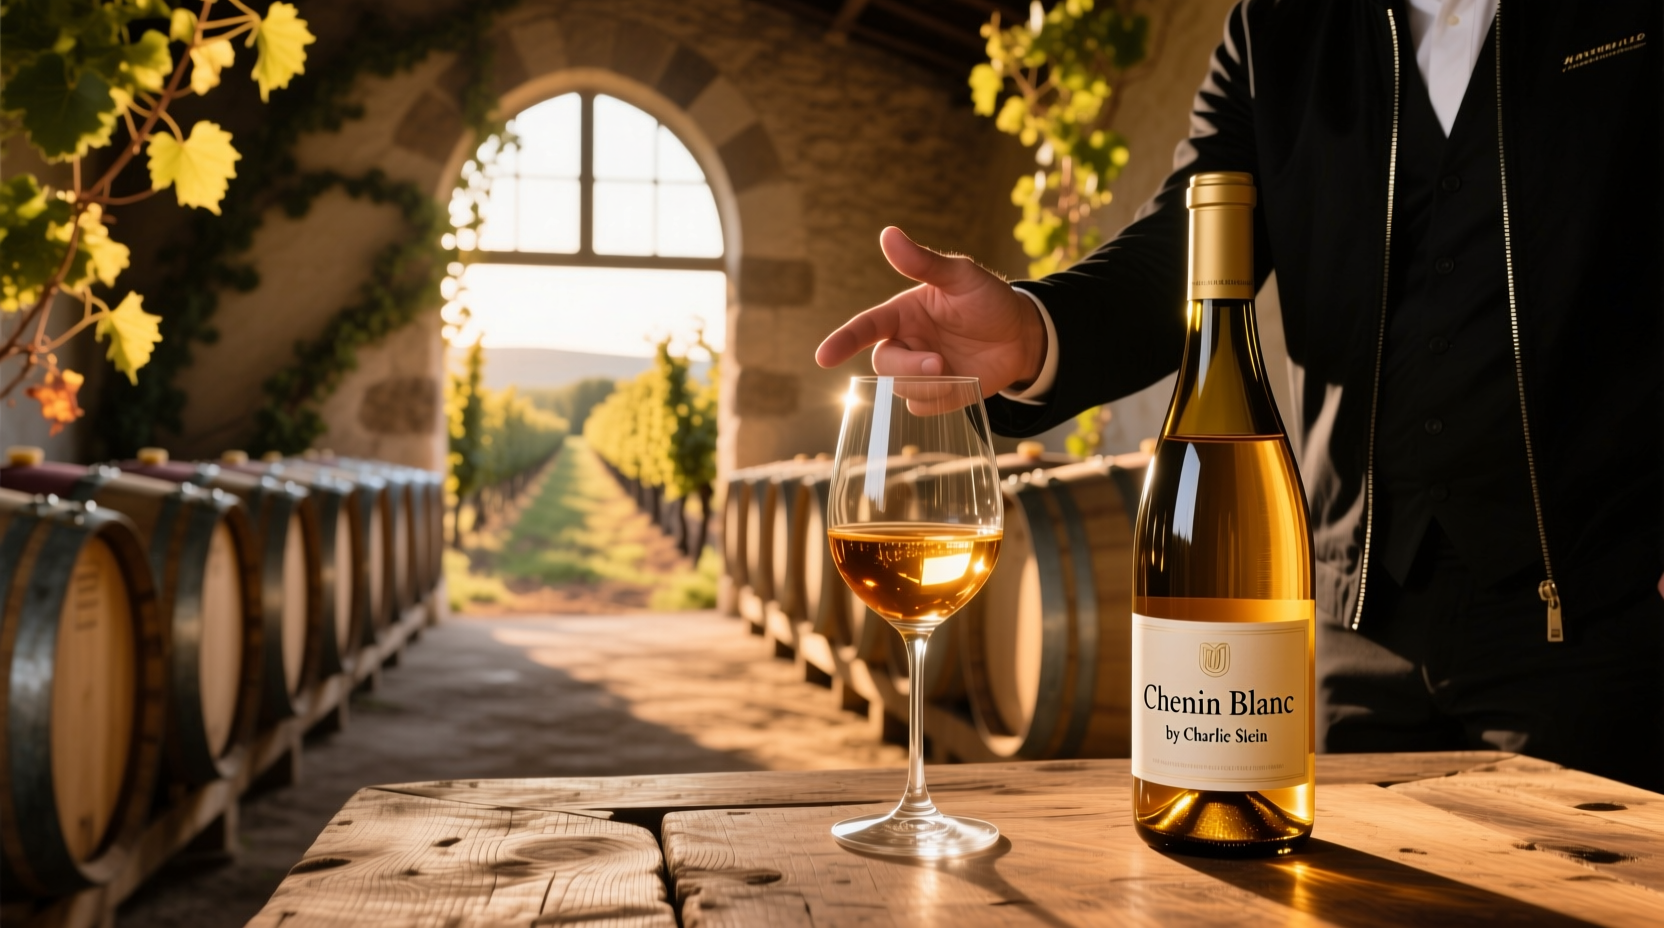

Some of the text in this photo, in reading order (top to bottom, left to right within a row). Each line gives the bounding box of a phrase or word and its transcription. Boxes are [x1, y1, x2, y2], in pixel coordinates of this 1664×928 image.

[1143, 684, 1294, 716] Chenin Blanc
[1165, 724, 1180, 744] by
[1183, 726, 1231, 743] Charlie
